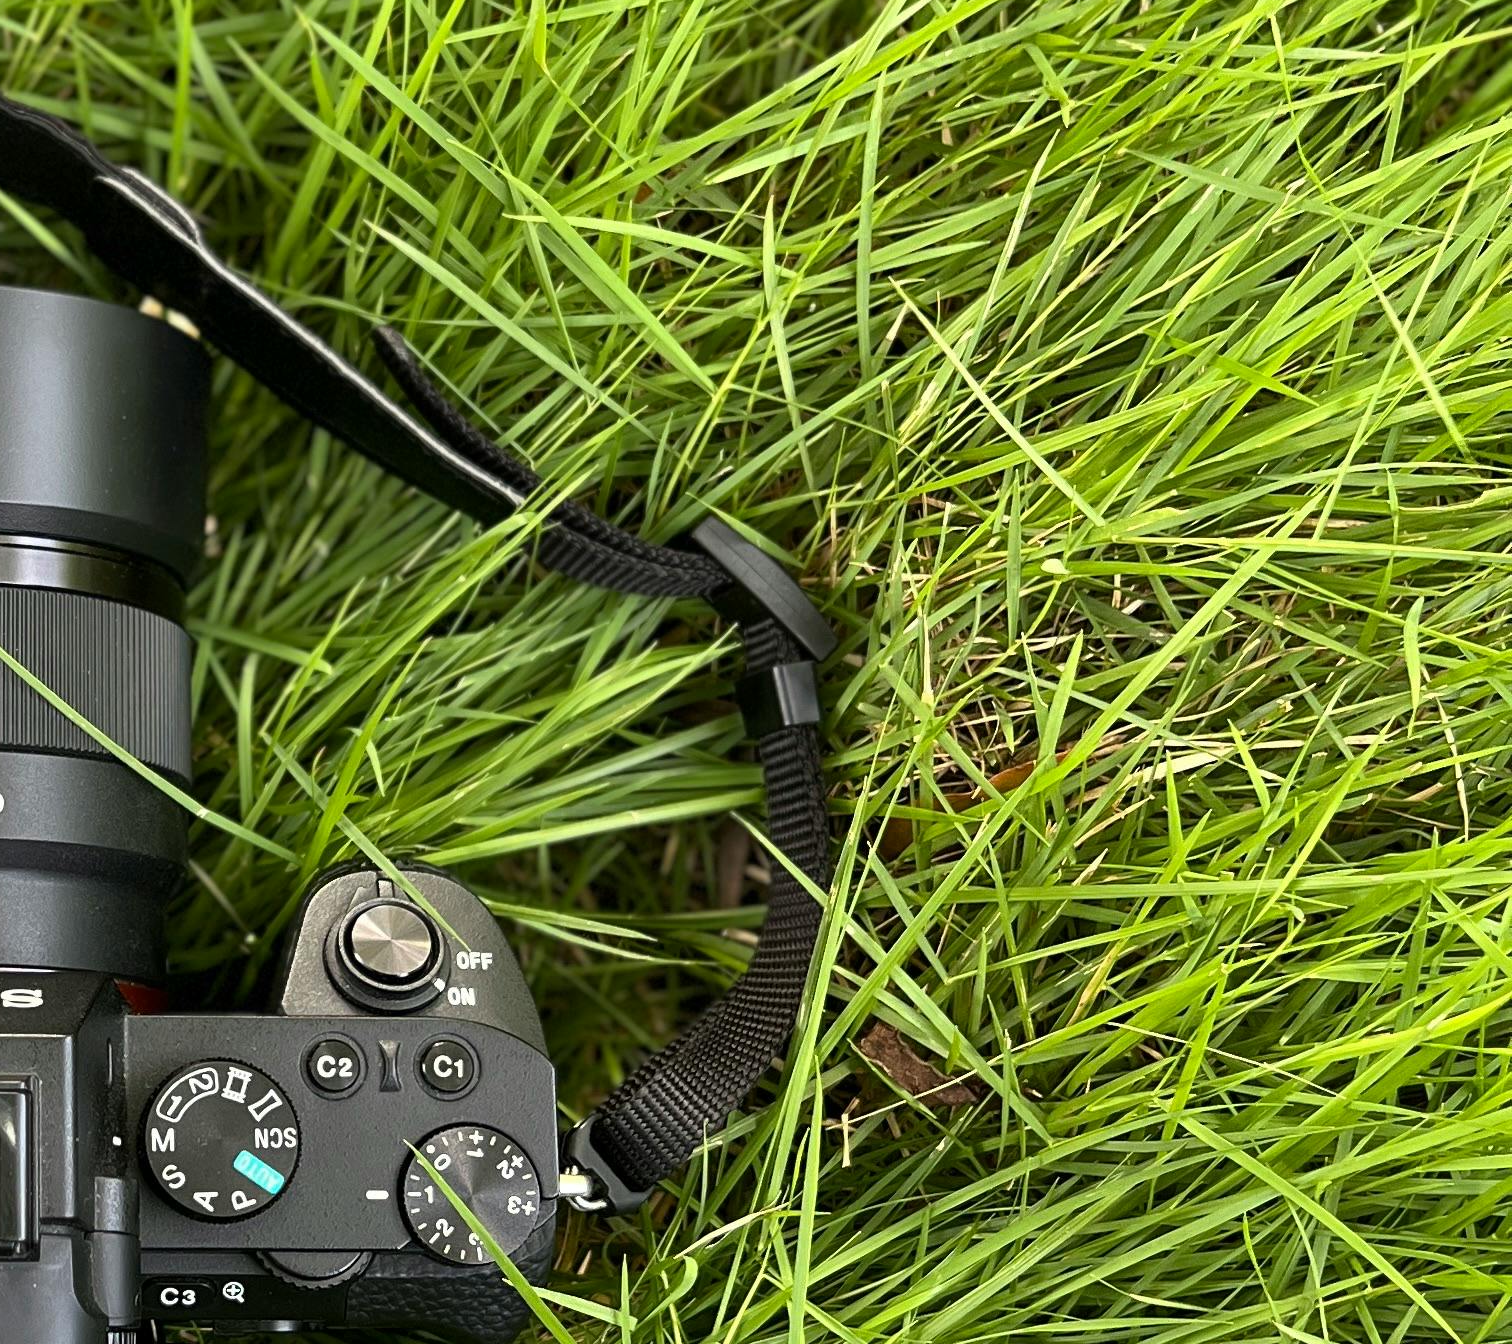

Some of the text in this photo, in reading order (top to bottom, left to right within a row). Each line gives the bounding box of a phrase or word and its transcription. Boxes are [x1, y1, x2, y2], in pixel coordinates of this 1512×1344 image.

[456, 951, 493, 970] OFF
[447, 986, 477, 1006] ON
[316, 1054, 354, 1078] C2
[432, 1054, 465, 1078] C1
[188, 1073, 214, 1094] 2
[166, 1095, 182, 1116] 1
[151, 1127, 176, 1153] M
[254, 1127, 297, 1149] SCN
[161, 1164, 186, 1189] S
[192, 1191, 219, 1213] A
[231, 1190, 257, 1211] P
[160, 1287, 196, 1306] C3
